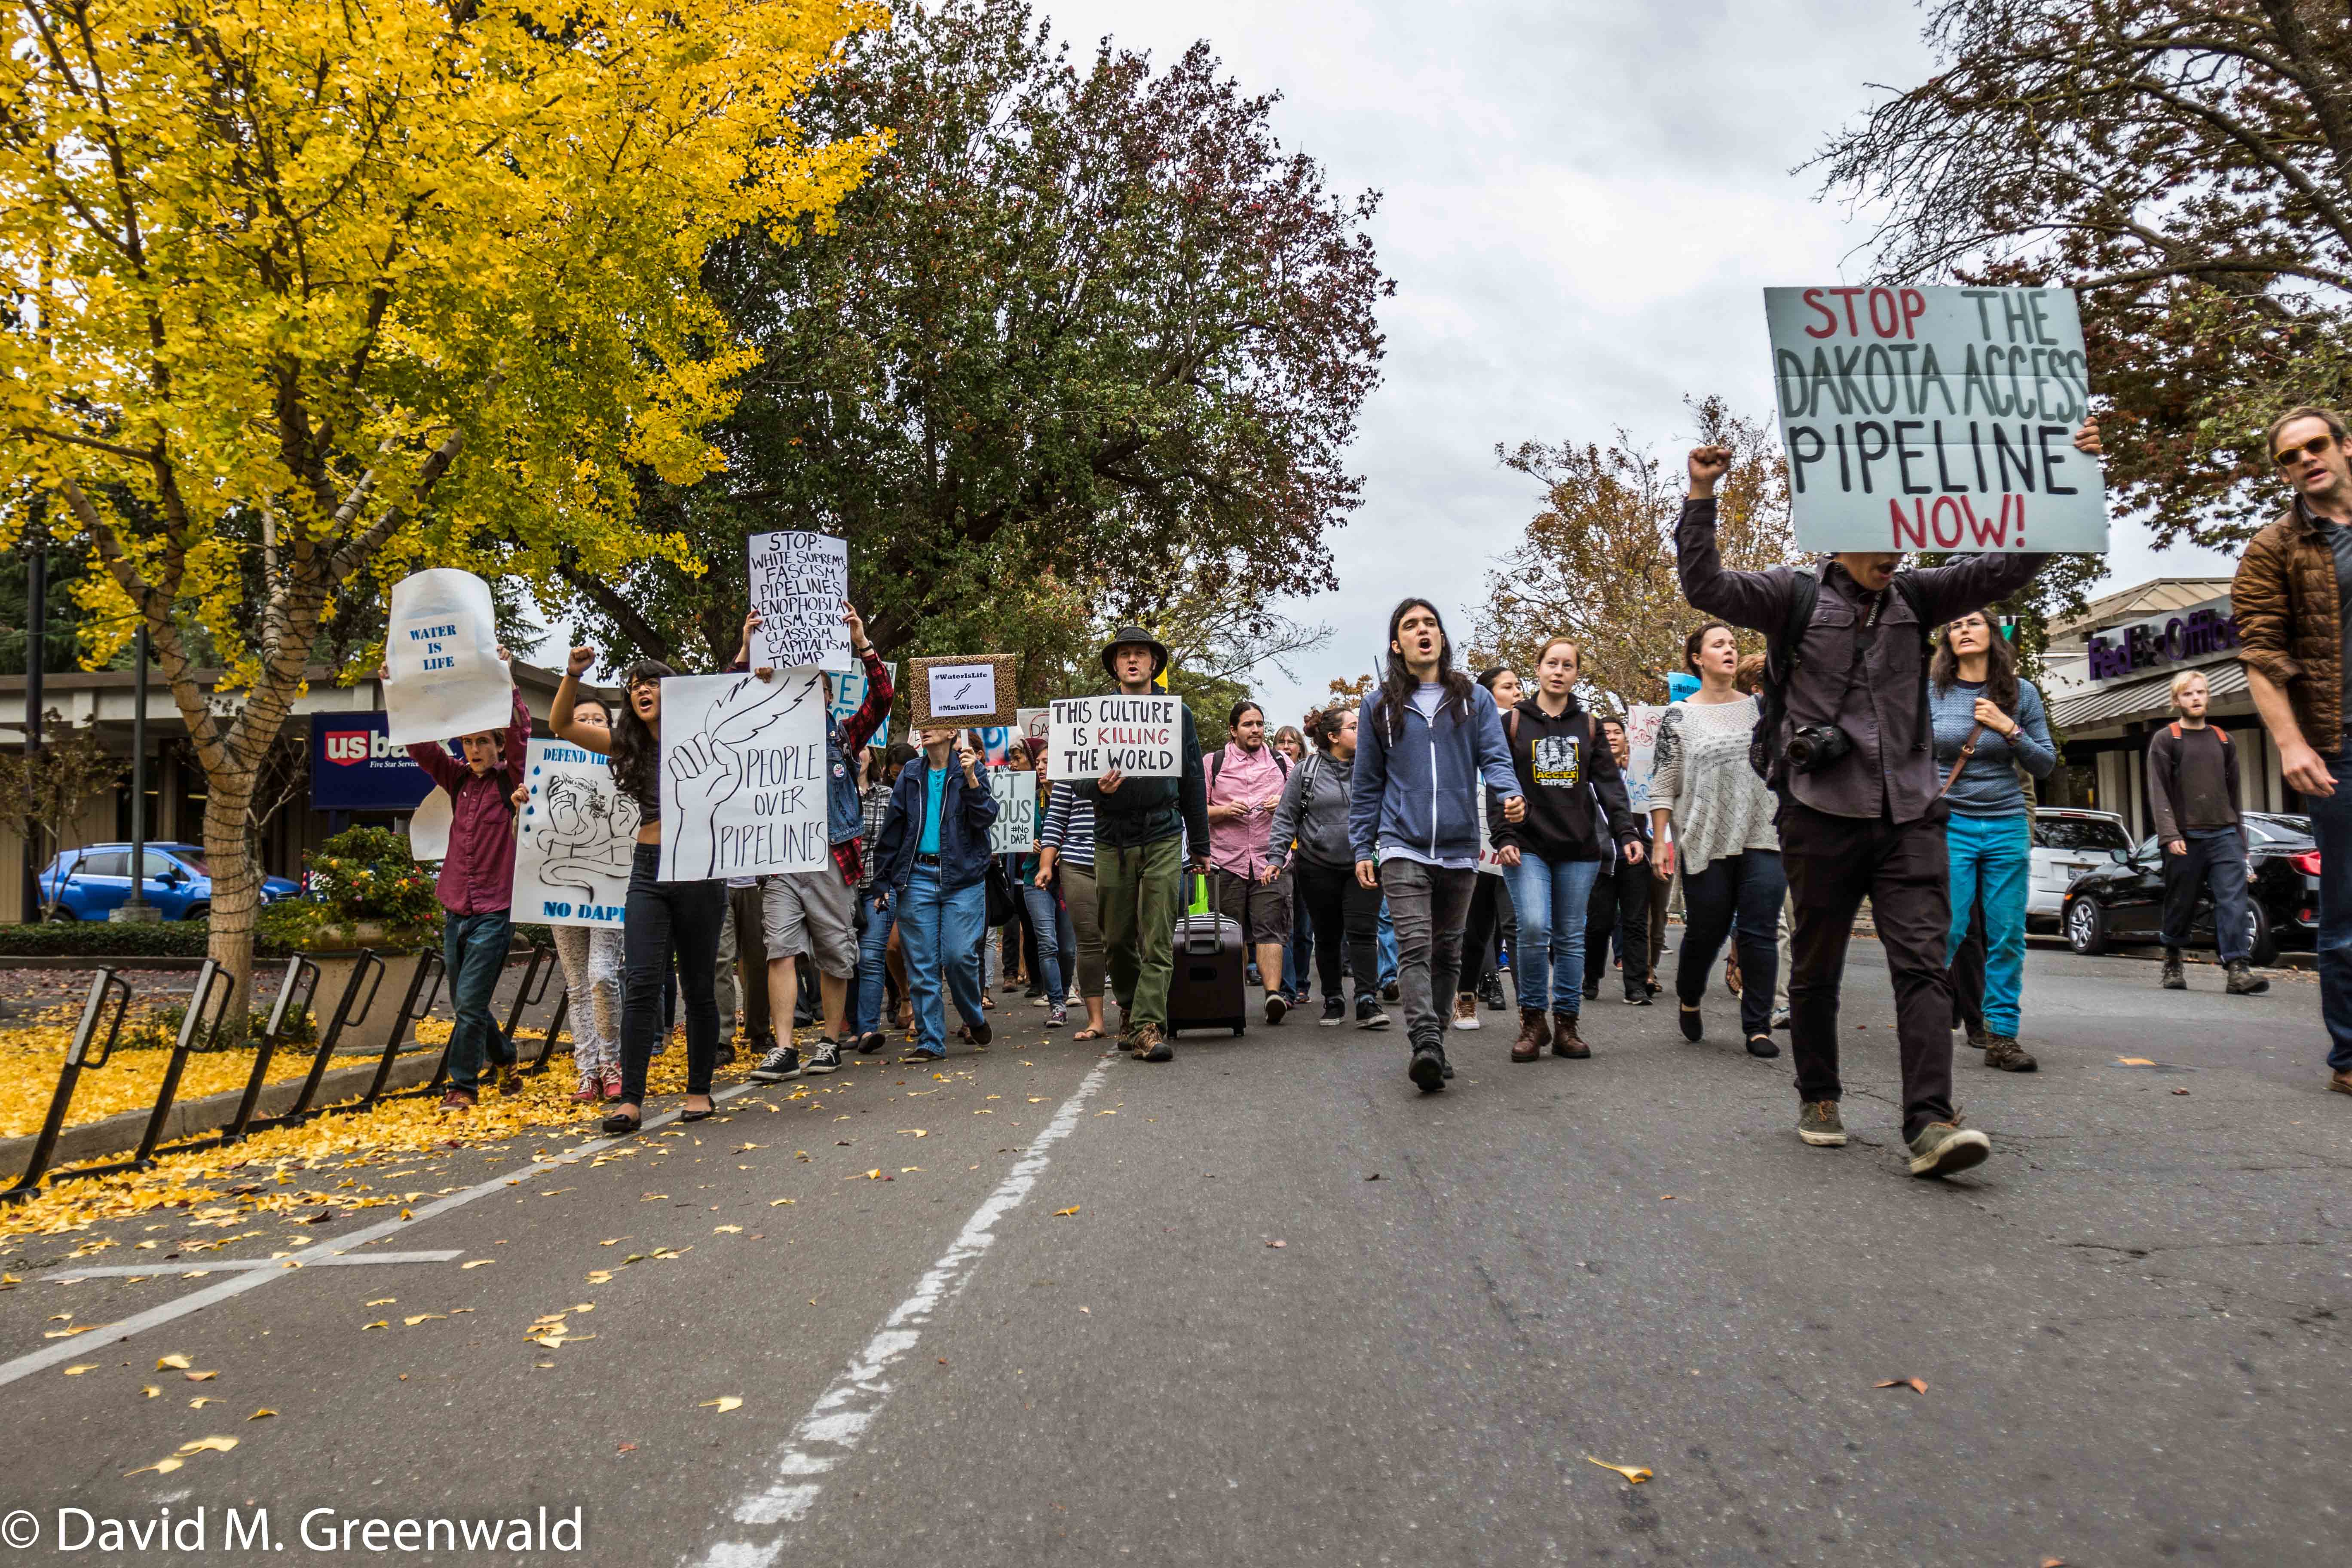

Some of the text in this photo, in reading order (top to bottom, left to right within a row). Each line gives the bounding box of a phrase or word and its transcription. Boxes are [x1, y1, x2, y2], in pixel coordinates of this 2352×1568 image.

[1803, 288, 2059, 345] STOP THE
[1776, 343, 2088, 424] DAKOTA ACCESS
[1788, 420, 2079, 495] PIPELINE
[1890, 493, 2026, 550] NOW!
[769, 533, 822, 551] STOP:
[751, 551, 792, 570] WHITE
[766, 564, 835, 583] FASCISM
[760, 578, 842, 600] PIPELINES
[752, 597, 845, 616] XENOPHOBIA
[410, 624, 456, 641] WATER
[766, 628, 832, 642] CLASSISM
[428, 642, 442, 654] IS
[768, 639, 849, 654] CAPITALISM
[2089, 624, 2165, 680] FedEx
[424, 655, 454, 670] LIFE
[768, 651, 824, 668] TRUMP
[1052, 700, 1174, 724] THIS CULTURE
[1073, 727, 1169, 746] IS KILLING
[543, 748, 586, 763] DEFEND
[1064, 749, 1173, 773] THE WORLD
[747, 744, 820, 788] PEOPLE
[755, 784, 807, 816] OVER
[1011, 824, 1029, 833] #No
[721, 821, 828, 870] PIPELINES
[1011, 834, 1030, 844] DAPL
[543, 901, 571, 917] NO
